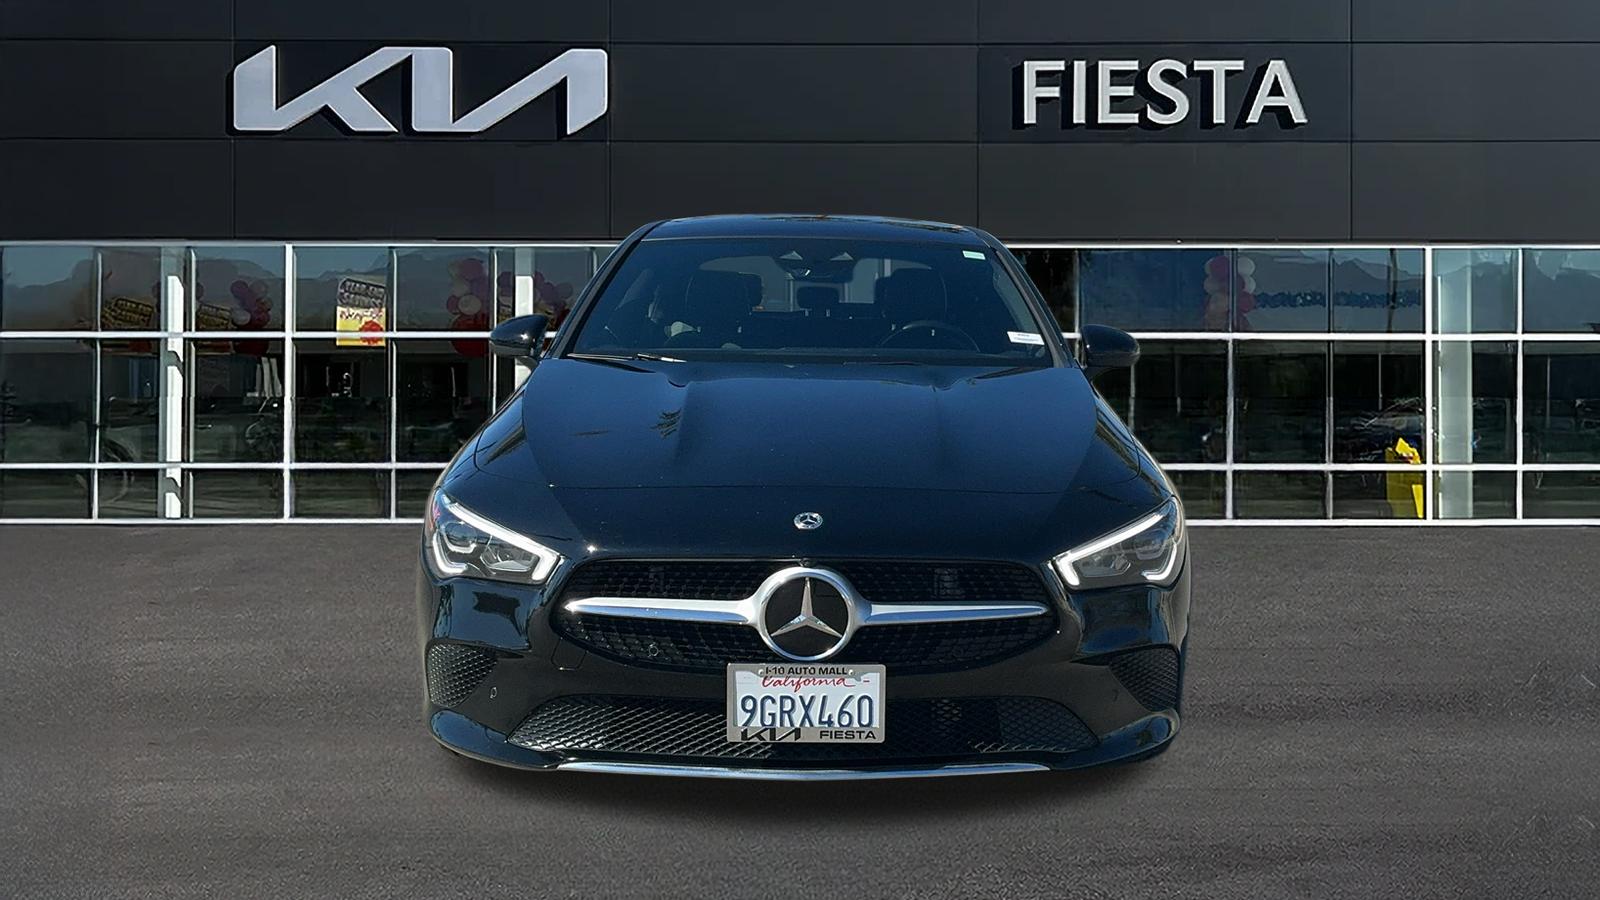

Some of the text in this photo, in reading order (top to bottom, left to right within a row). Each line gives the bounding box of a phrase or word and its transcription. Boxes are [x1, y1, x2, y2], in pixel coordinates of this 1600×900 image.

[1023, 59, 1308, 125] FIESTA
[765, 667, 848, 675] I-10 AUTO MALL
[762, 677, 856, 693] California
[740, 694, 874, 728] 9GRX460
[819, 730, 876, 740] FIESTA
